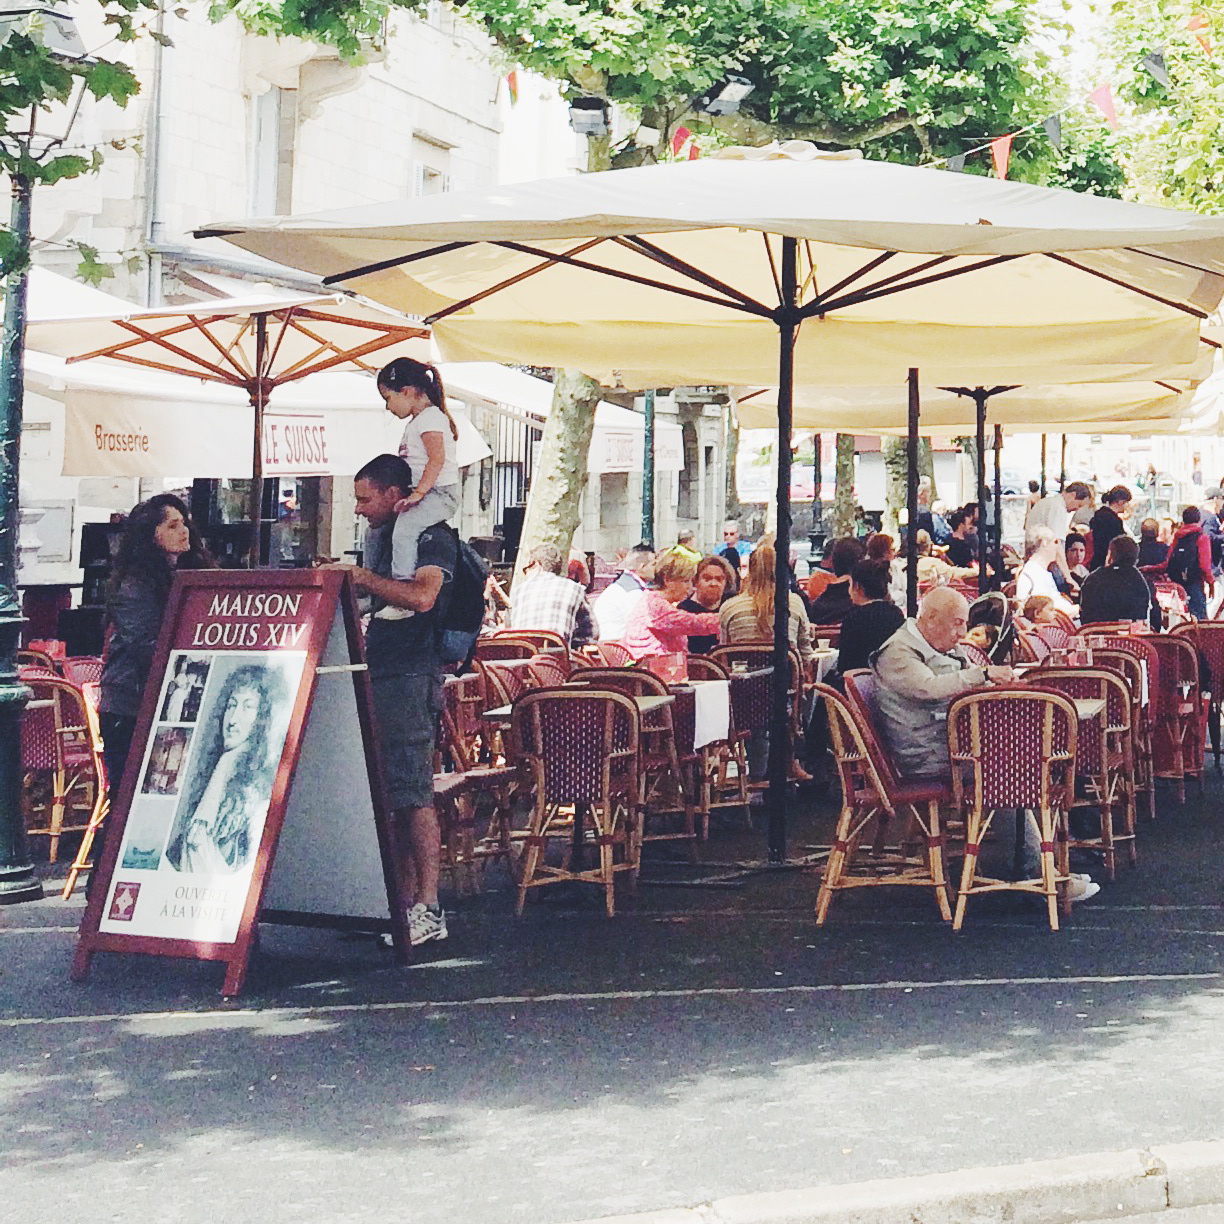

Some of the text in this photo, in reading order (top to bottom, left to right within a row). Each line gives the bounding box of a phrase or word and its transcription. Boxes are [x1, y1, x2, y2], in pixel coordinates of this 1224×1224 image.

[94, 424, 149, 453] Brasserie
[264, 425, 329, 465] LE SUISSE
[207, 593, 303, 617] MAISON
[191, 622, 308, 647] LOUIS XIV
[175, 885, 230, 903] OUVERTE
[171, 904, 185, 918] LA
[190, 904, 227, 921] VISITE
